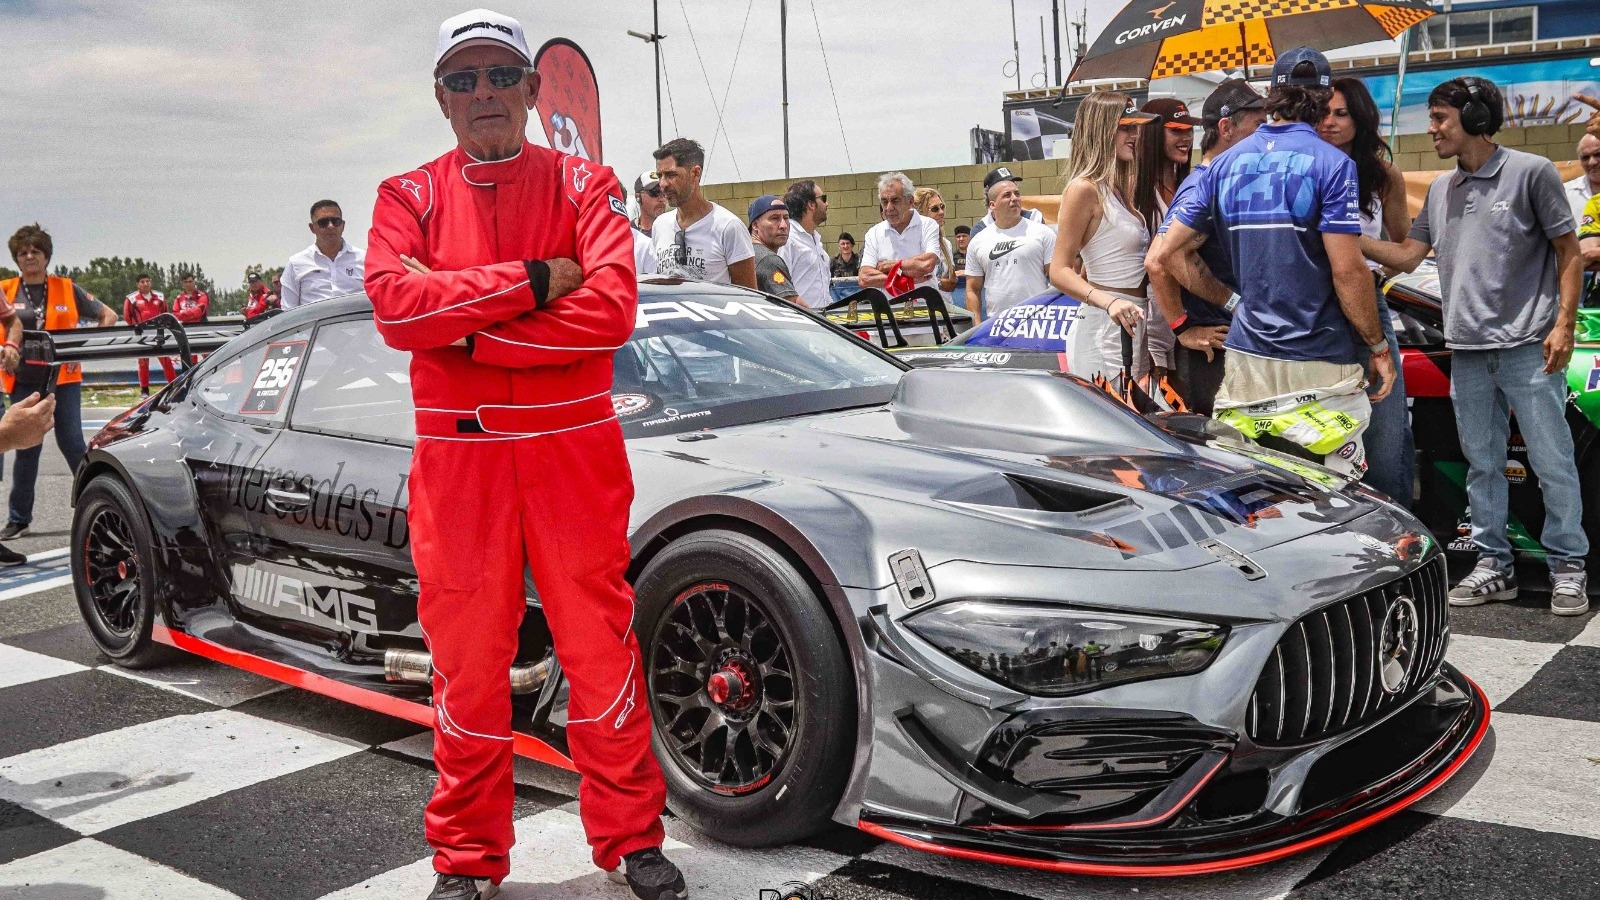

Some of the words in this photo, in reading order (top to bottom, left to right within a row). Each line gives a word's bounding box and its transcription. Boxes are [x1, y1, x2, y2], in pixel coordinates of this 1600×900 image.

[467, 21, 514, 37] AMG
[1114, 13, 1187, 45] CORVEN
[993, 240, 1017, 251] NIKE
[634, 301, 820, 329] AMG
[253, 357, 299, 389] 256
[680, 410, 712, 420] PARTS
[270, 574, 380, 637] AMG
